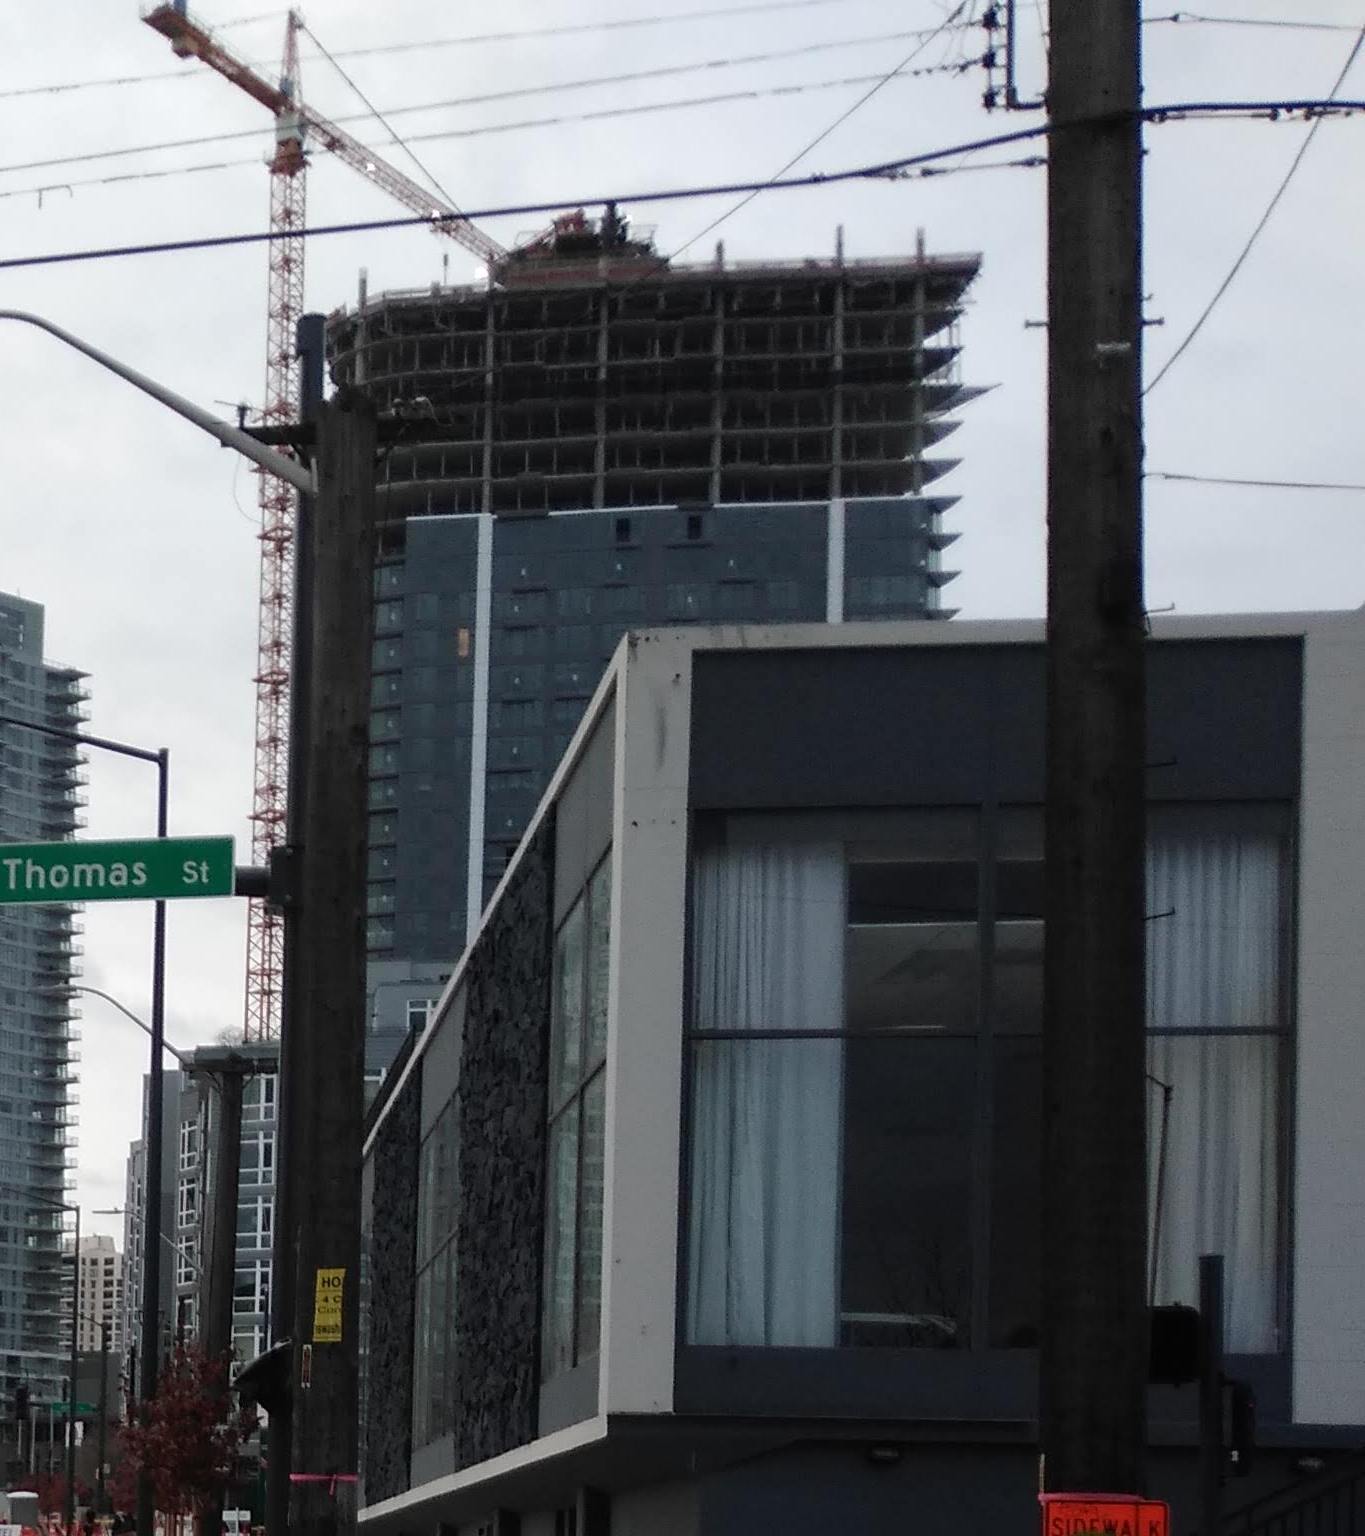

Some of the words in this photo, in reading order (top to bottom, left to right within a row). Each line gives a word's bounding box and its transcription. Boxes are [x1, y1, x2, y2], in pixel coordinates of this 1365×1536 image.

[3, 858, 147, 890] Thomas
[182, 860, 210, 884] St
[321, 1276, 341, 1288] HO
